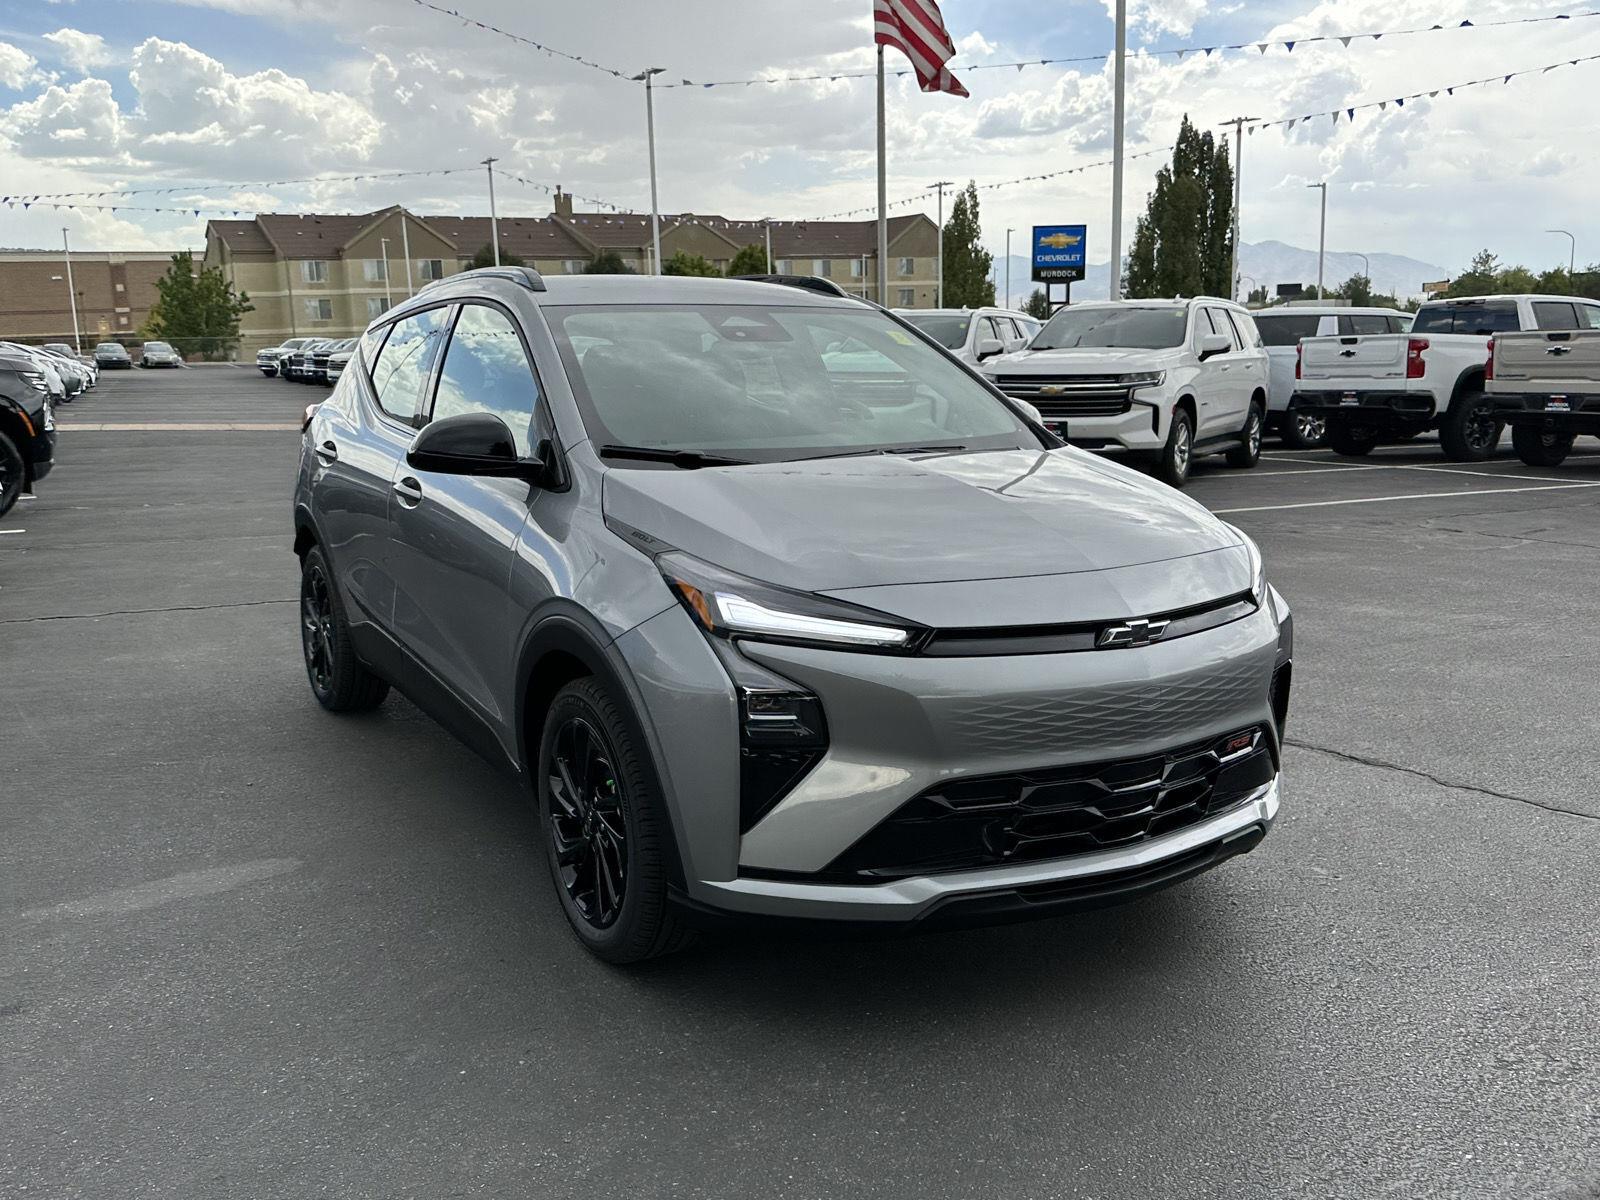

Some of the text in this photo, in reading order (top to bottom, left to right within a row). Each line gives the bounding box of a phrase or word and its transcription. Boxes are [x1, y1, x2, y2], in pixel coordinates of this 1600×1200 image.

[1037, 254, 1081, 262] CHEVROLET
[1040, 270, 1077, 278] MURDOCK
[631, 531, 656, 544] BOLT
[1226, 735, 1251, 751] RS
